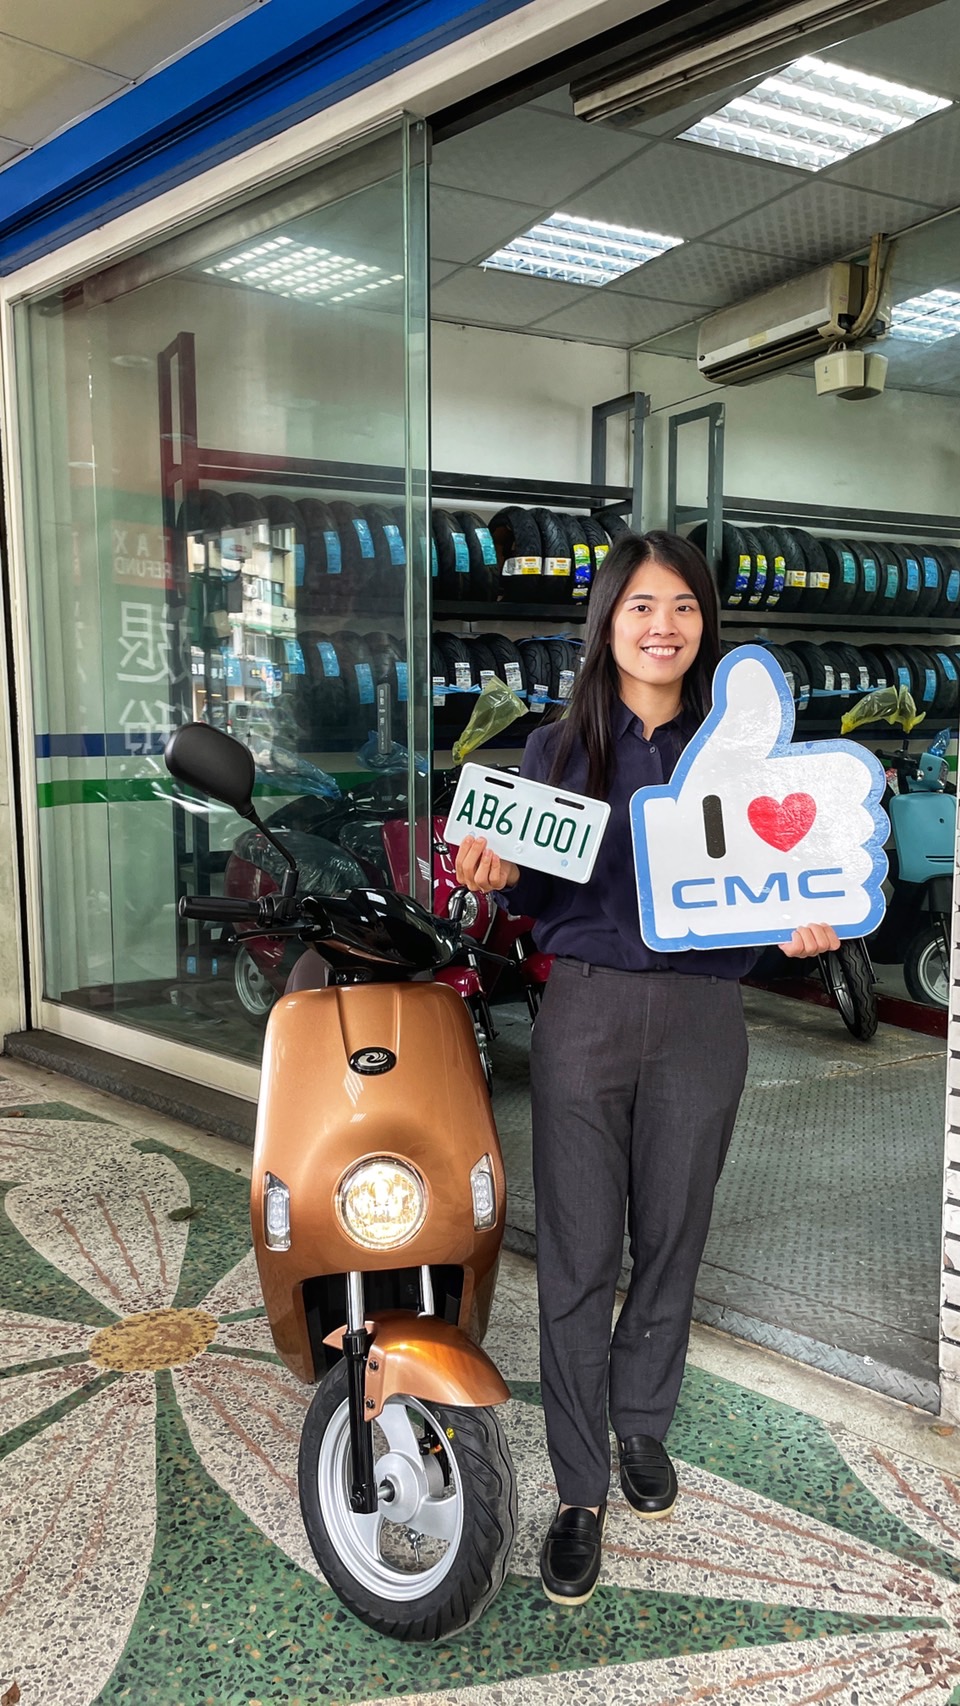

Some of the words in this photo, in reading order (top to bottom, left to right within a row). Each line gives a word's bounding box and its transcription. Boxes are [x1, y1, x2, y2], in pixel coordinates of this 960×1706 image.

[456, 789, 591, 858] AB61001
[702, 794, 727, 859] I
[671, 867, 846, 910] CMC
